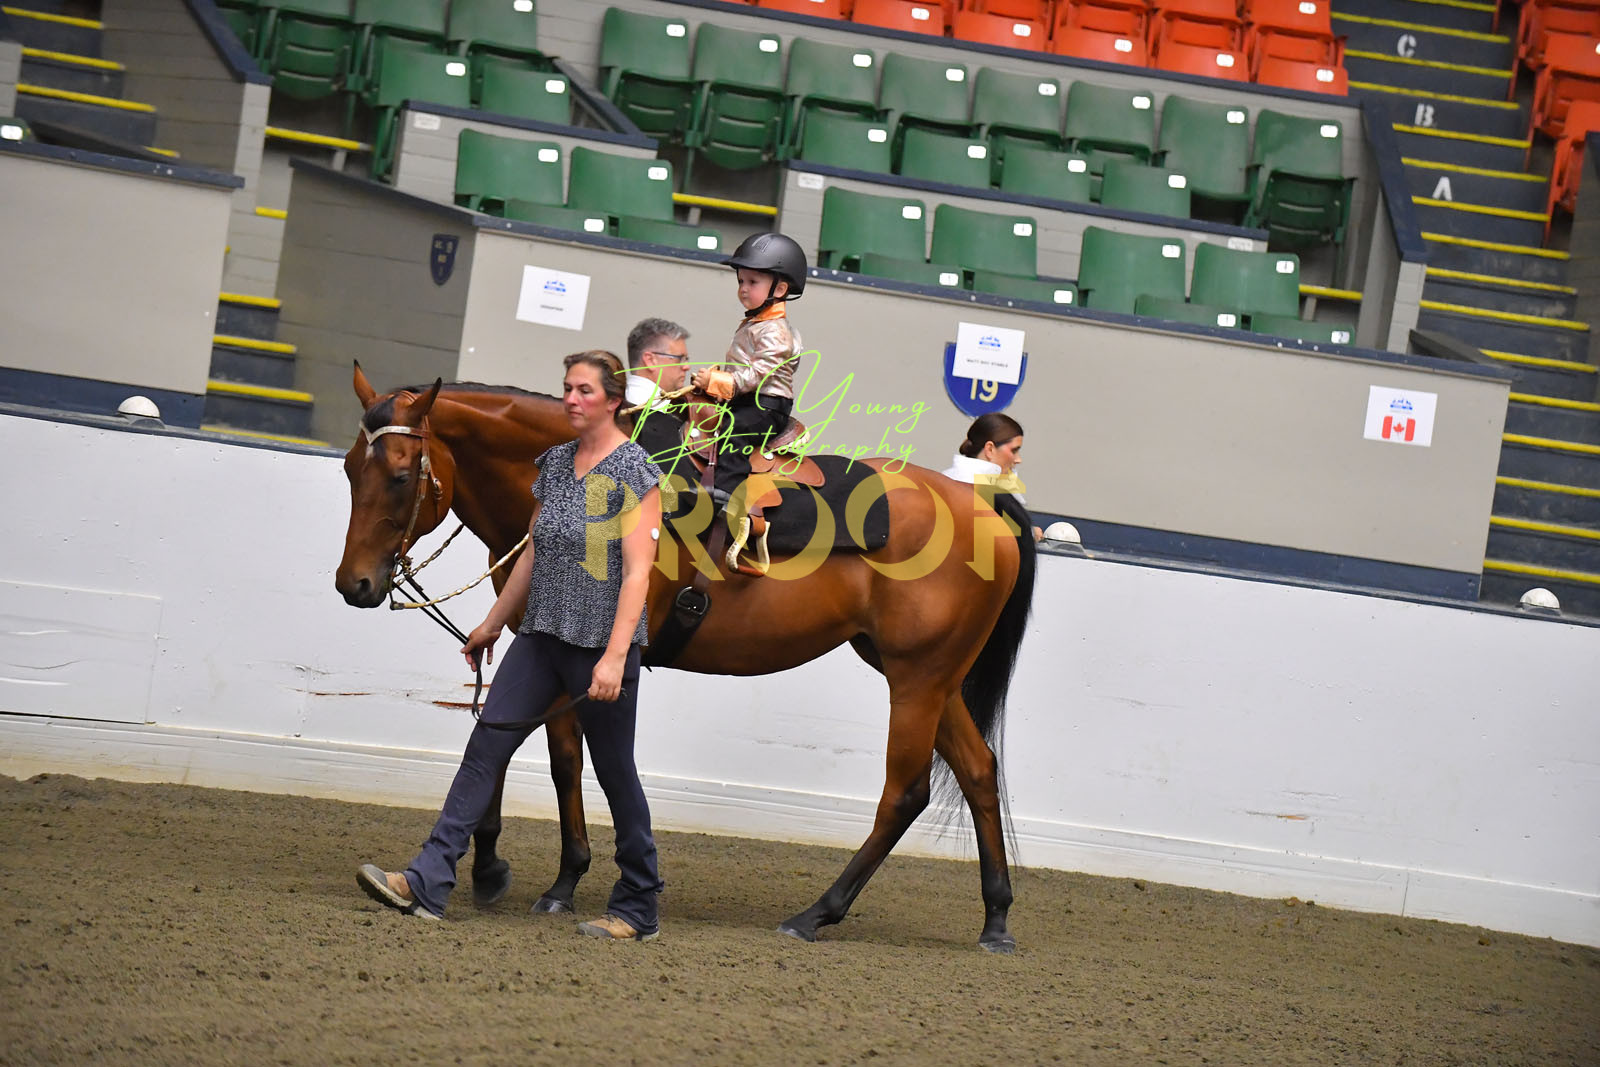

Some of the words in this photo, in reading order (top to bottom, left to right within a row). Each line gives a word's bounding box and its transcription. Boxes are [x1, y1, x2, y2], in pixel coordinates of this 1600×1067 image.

[1397, 33, 1417, 58] C
[1414, 103, 1435, 127] B
[1432, 175, 1452, 201] A
[970, 378, 999, 402] 19
